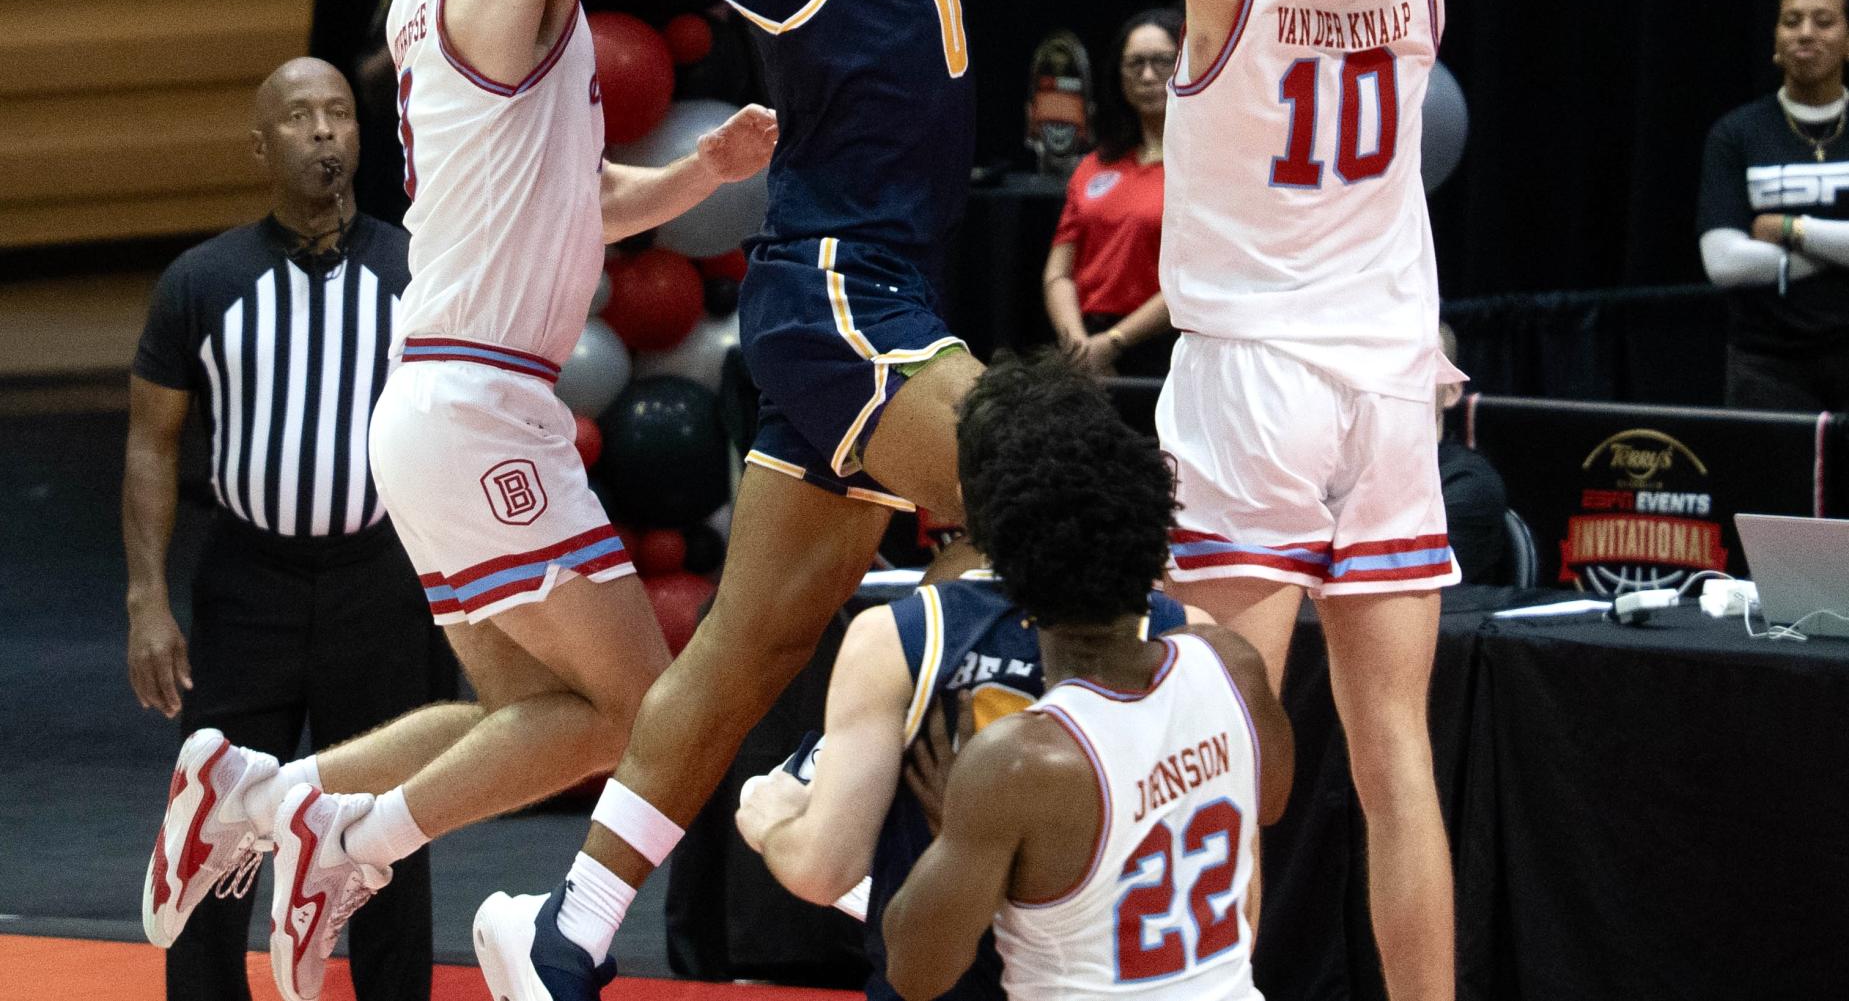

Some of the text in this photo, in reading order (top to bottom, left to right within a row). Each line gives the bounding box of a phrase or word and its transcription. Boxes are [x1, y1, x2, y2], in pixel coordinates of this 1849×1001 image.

[1277, 1, 1411, 49] VAN DER KNAAP
[1267, 46, 1400, 189] 10
[493, 469, 537, 518] B
[1635, 491, 1712, 515] EVENTS
[1572, 518, 1714, 567] INVITATIONAL
[1113, 796, 1243, 984] 22
